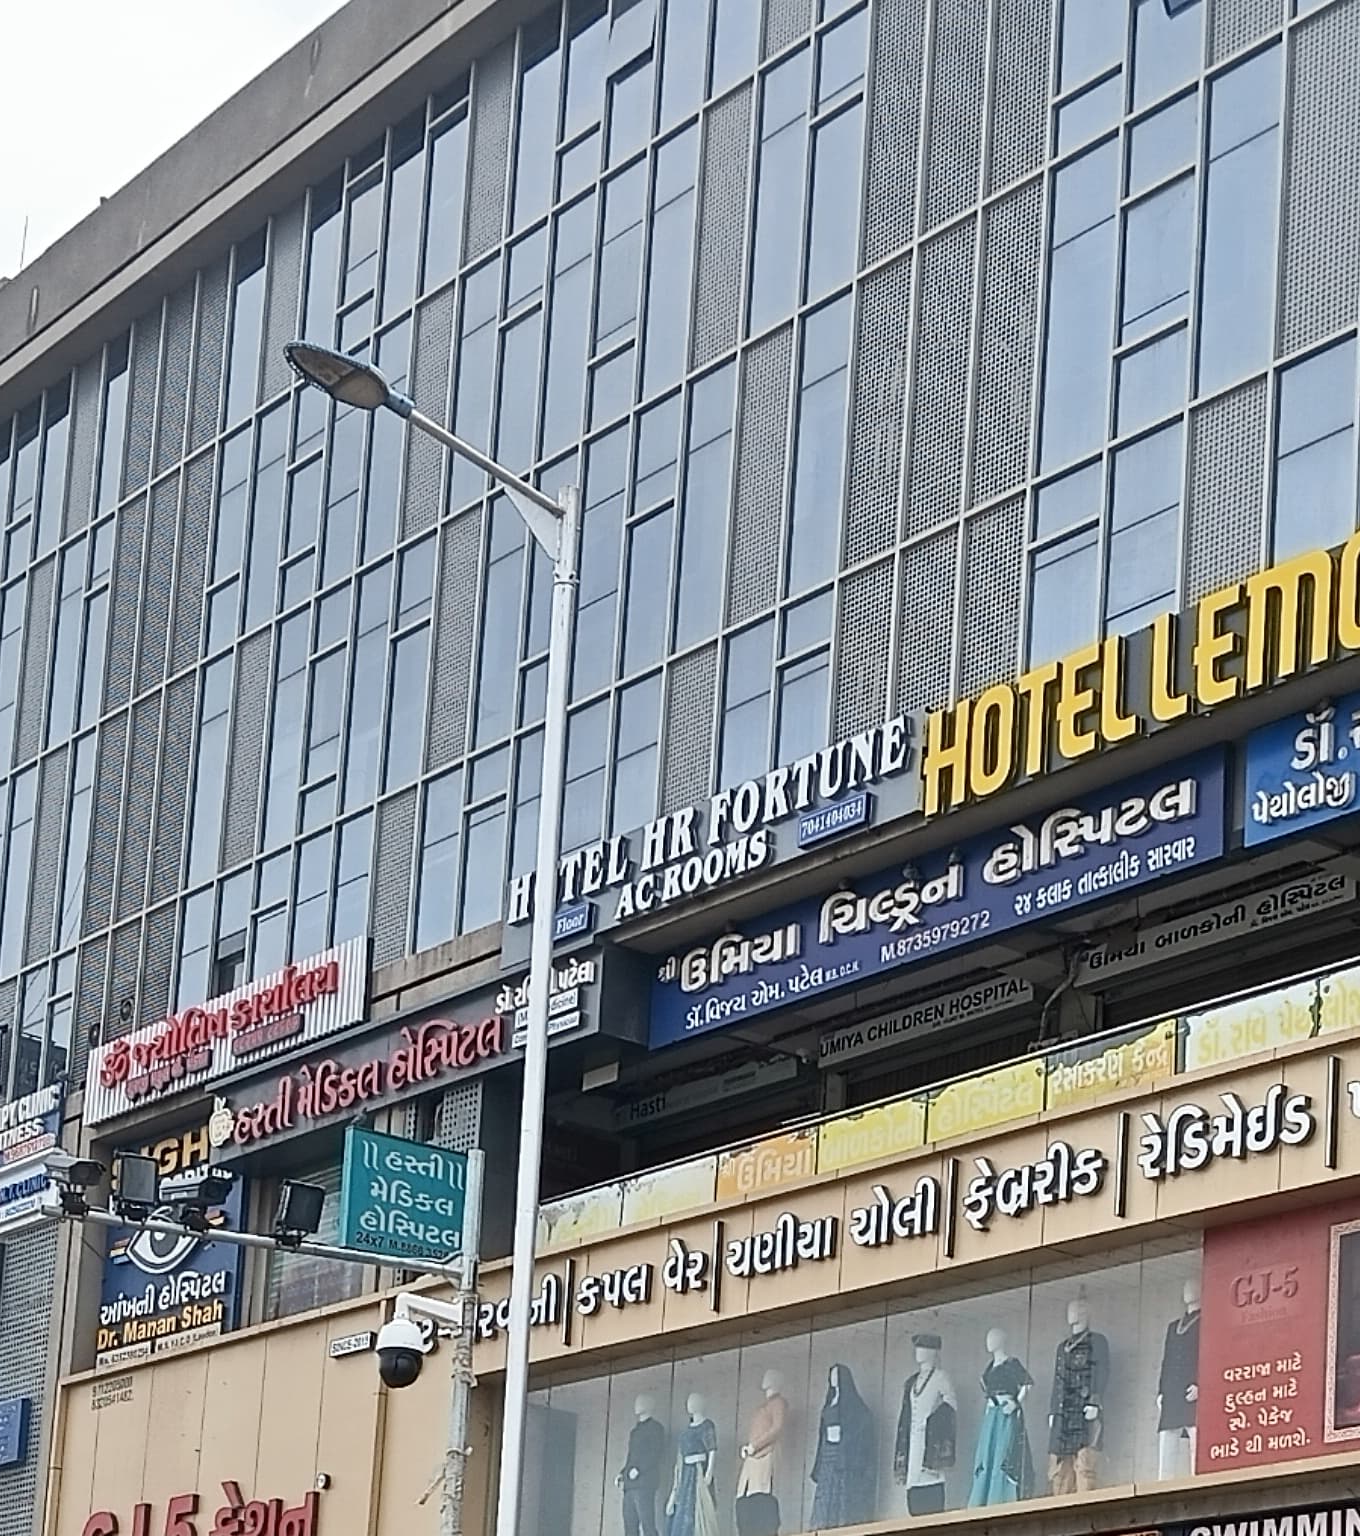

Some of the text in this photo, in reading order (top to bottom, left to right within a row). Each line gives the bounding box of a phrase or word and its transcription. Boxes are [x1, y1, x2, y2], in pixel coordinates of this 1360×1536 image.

[922, 635, 1140, 817] HOTEL
[641, 715, 913, 871] HR FORTUNE
[1251, 771, 1356, 825] પેથોલોજી
[614, 830, 772, 921] AC ROOMS
[679, 923, 800, 993] ઉમિયા
[981, 778, 1197, 885] હોસ્પિટલ
[1035, 879, 1074, 910] કલાક
[1147, 836, 1196, 874] સારવાર
[555, 911, 586, 934] Floor
[1154, 905, 1247, 950] બાળકોની
[788, 965, 824, 1000] પટેલ
[819, 975, 1030, 1058] UMIYA CHILDREN HOSPITAL
[233, 1075, 292, 1145] હસ્તી
[297, 1059, 382, 1119] મેડિકલ
[386, 1014, 505, 1090] હોસ્પિટલ
[384, 1149, 443, 1180] હસ્તી
[369, 1175, 454, 1217] મેડિકલ
[356, 1230, 385, 1248] 24x7
[359, 1205, 460, 1249] હોસ્પિટલ
[726, 1175, 941, 1279] ચણીયા ચોલી
[100, 1270, 227, 1326] આંખની હોસ્પિટલ
[576, 1237, 709, 1317] કપલ વેર
[1230, 1265, 1300, 1309] GJ-5
[97, 1329, 118, 1350] Dr.
[122, 1315, 177, 1345] Manan
[180, 1299, 224, 1331] Shah
[1276, 1351, 1303, 1374] માટે
[1224, 1377, 1298, 1413] દુલ્હન માટે
[1257, 1406, 1294, 1429] પેકેજ
[1209, 1432, 1263, 1460] ભાડે થી
